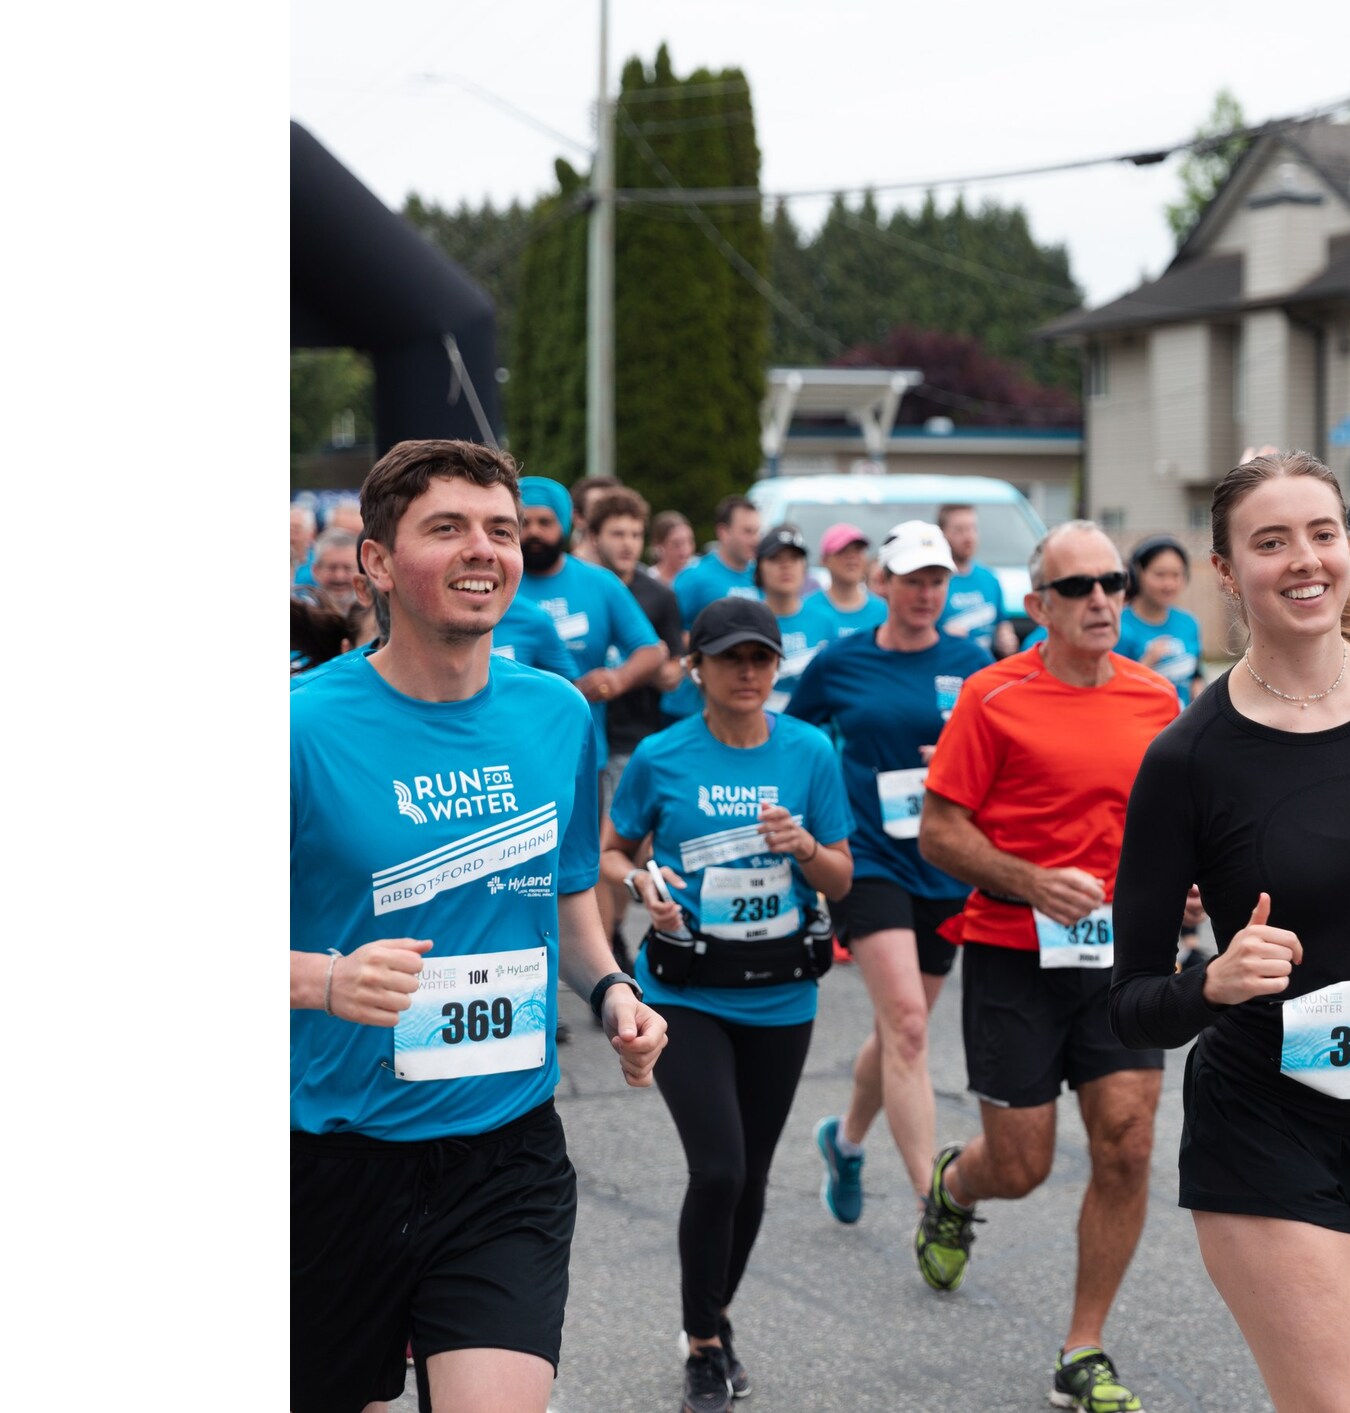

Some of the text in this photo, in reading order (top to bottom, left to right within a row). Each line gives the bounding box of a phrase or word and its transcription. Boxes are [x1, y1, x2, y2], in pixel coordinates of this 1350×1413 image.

[414, 768, 513, 800] RUN FOR
[711, 785, 756, 802] RUN
[427, 792, 519, 821] WATER
[717, 802, 762, 817] WAT
[380, 858, 484, 906] ABBOTSFORD
[498, 829, 553, 861] JAHANA
[508, 872, 552, 891] HyLand
[732, 894, 779, 922] 239
[1064, 919, 1108, 945] 326
[418, 969, 442, 981] UN
[468, 969, 489, 985] 10K
[507, 962, 540, 976] HyLand
[1304, 1004, 1343, 1014] WATER
[441, 996, 513, 1044] 369
